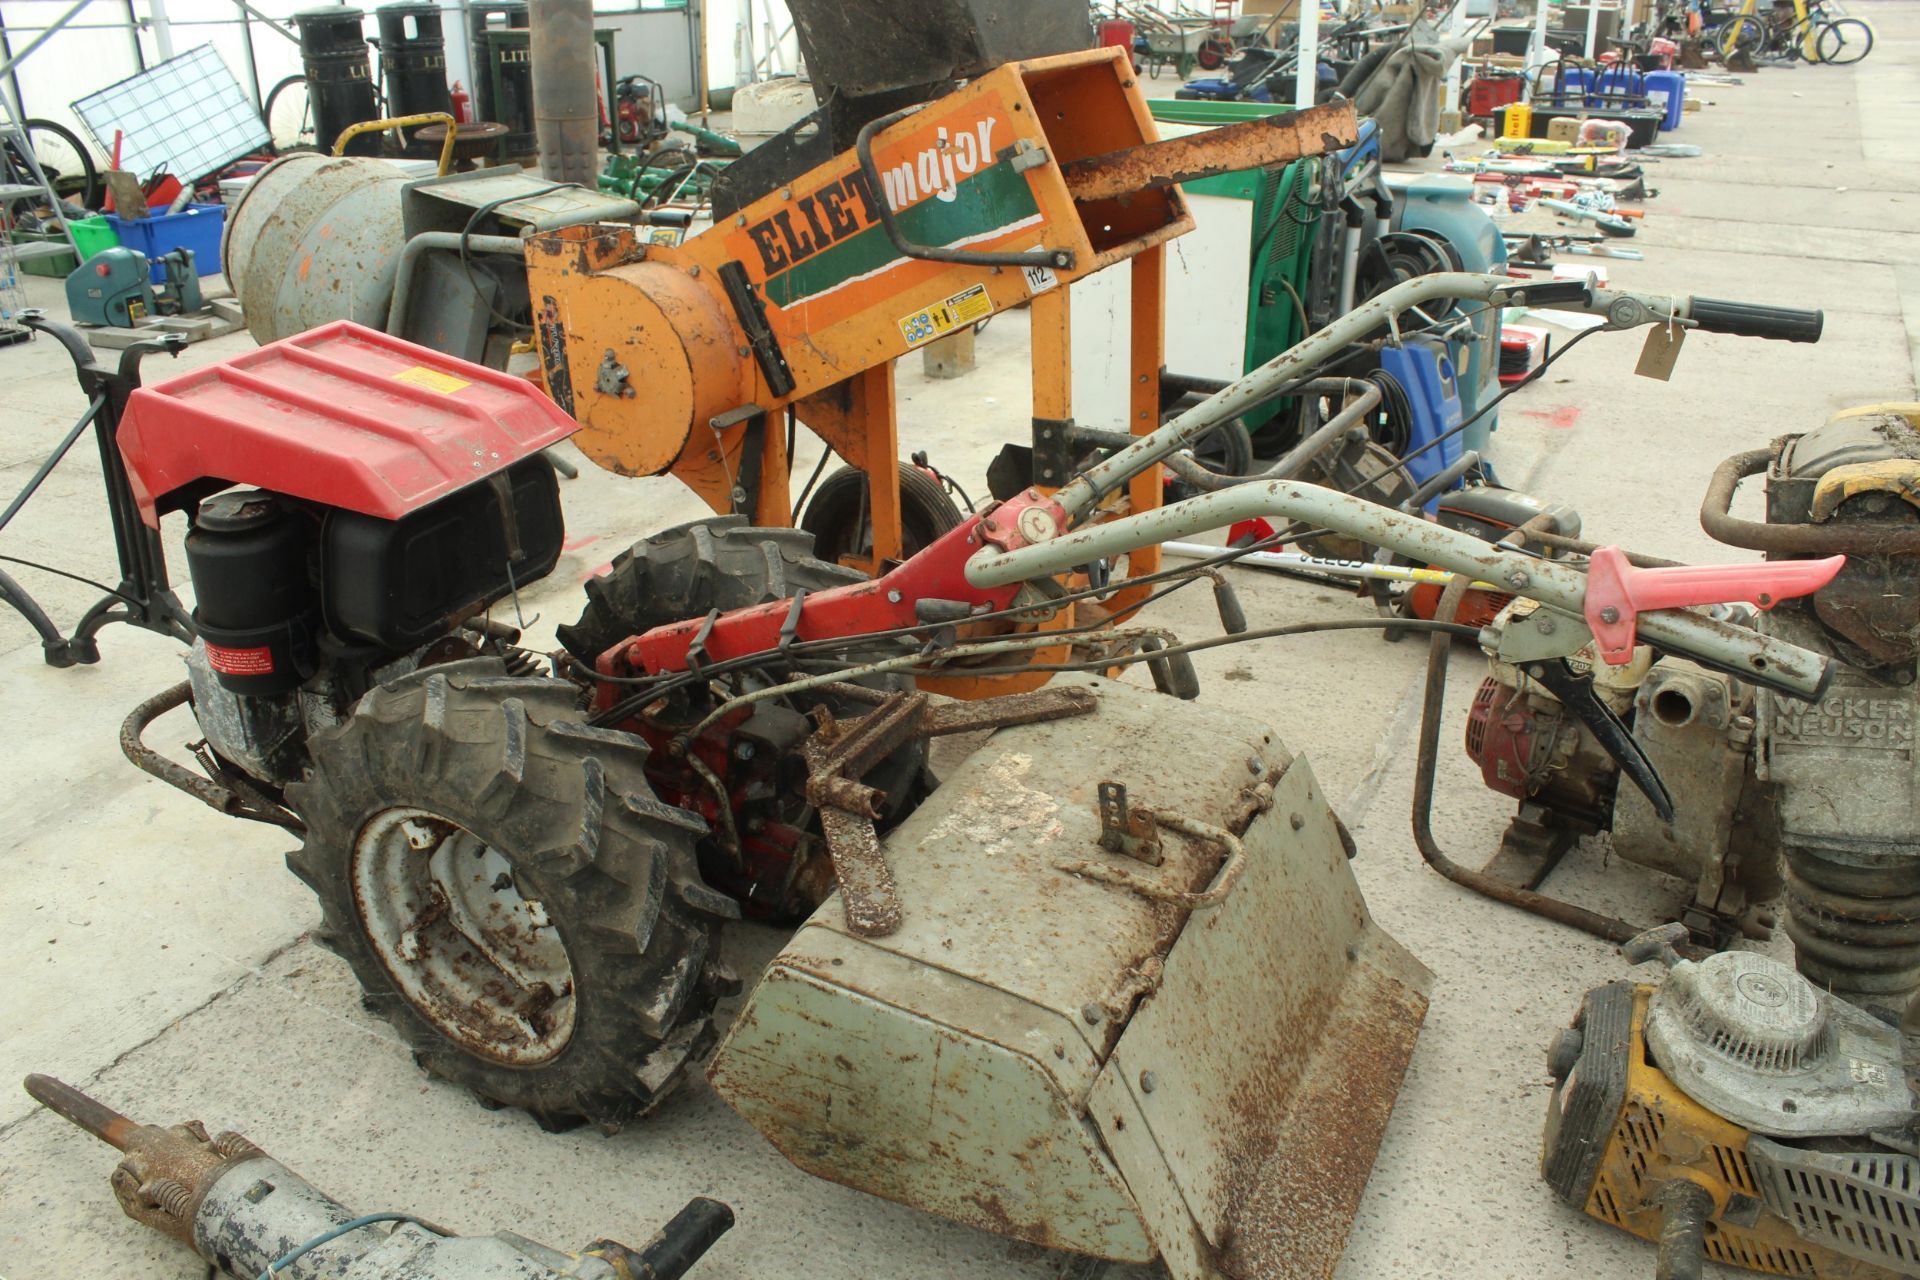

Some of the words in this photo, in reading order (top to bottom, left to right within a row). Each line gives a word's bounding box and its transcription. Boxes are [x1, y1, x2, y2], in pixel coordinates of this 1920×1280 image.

[500, 50, 530, 63] LIT
[747, 168, 881, 277] ELIET
[882, 117, 996, 211] major
[1028, 266, 1047, 286] 112
[1776, 716, 1915, 740] NEUSON
